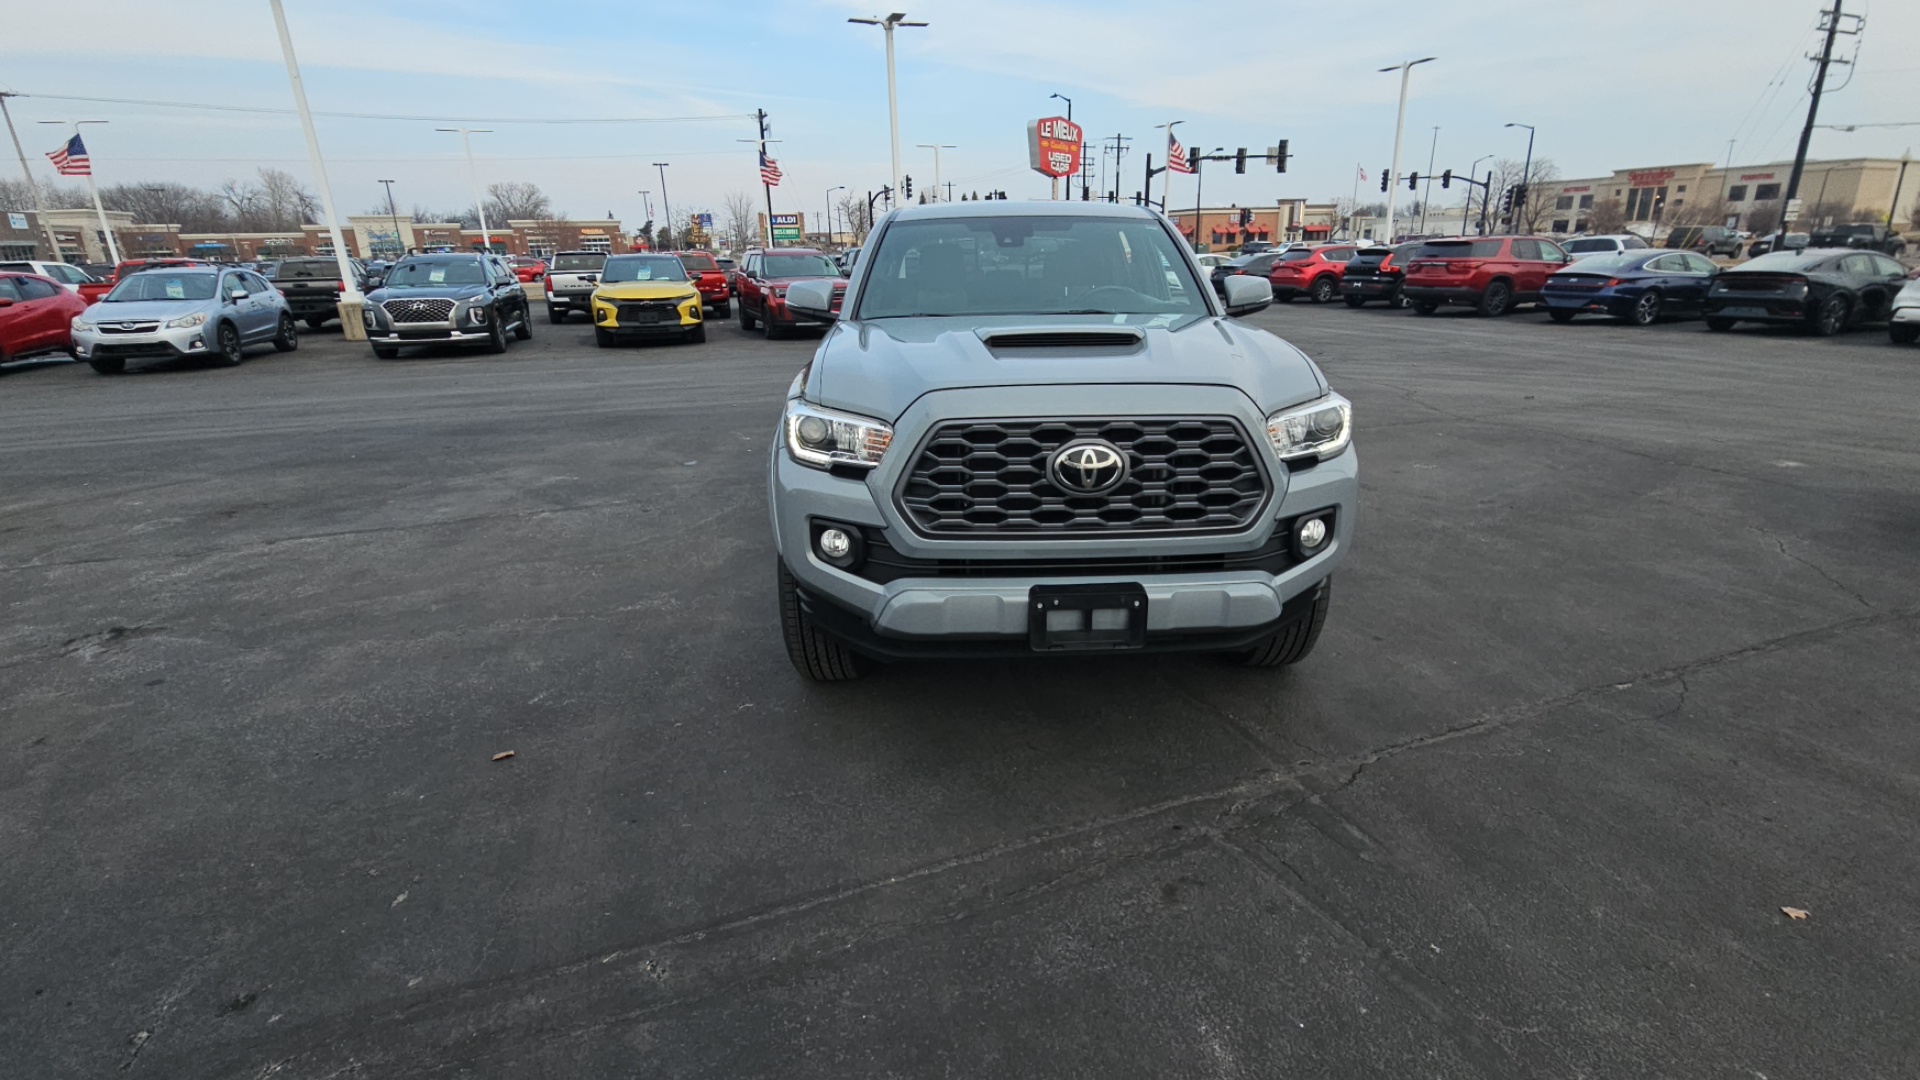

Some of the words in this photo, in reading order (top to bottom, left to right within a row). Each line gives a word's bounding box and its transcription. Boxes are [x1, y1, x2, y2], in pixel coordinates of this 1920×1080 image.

[1040, 121, 1051, 138] LE
[1048, 151, 1072, 163] USED
[1050, 162, 1070, 173] CARS
